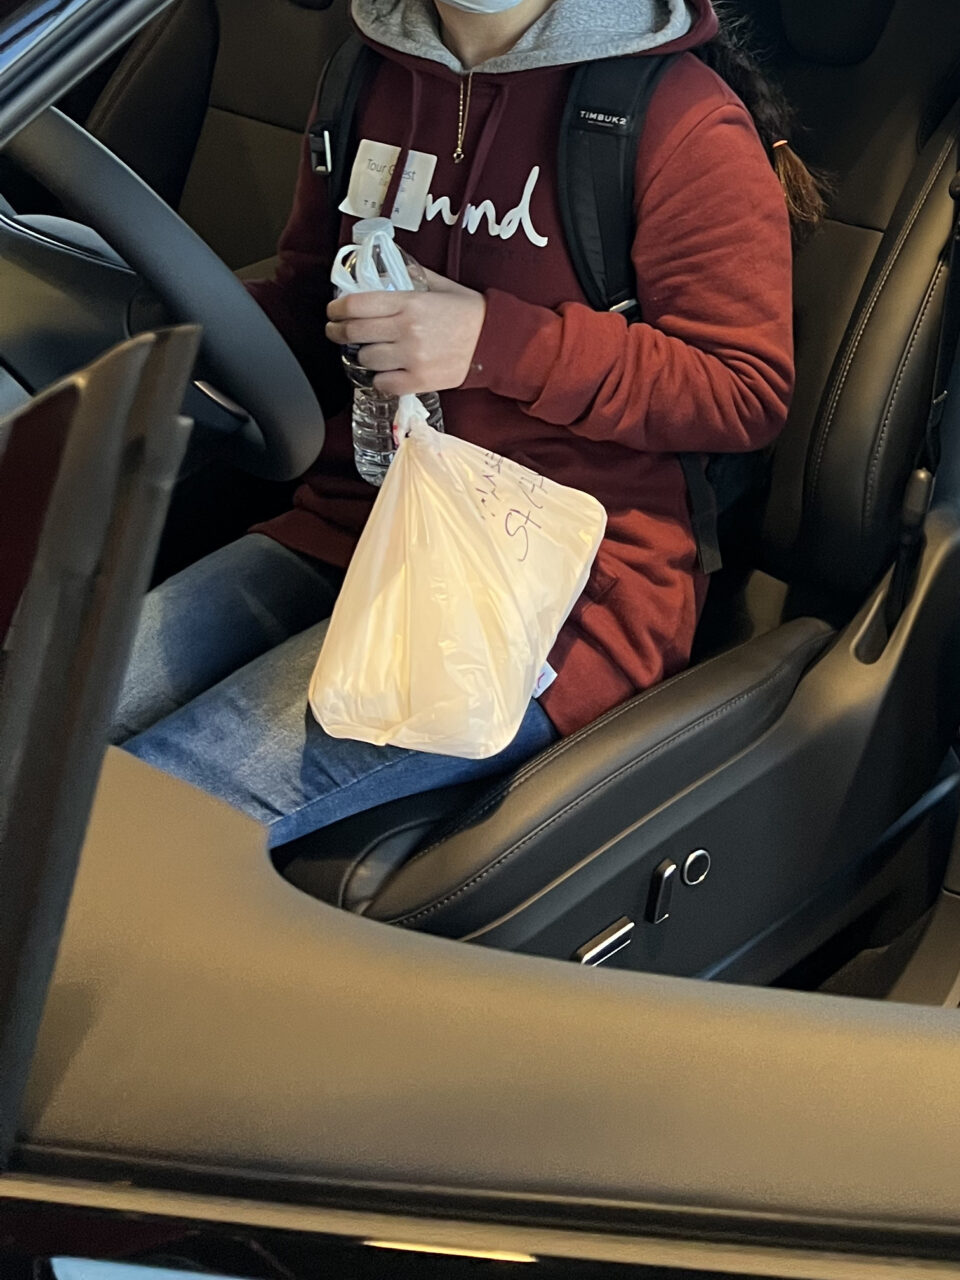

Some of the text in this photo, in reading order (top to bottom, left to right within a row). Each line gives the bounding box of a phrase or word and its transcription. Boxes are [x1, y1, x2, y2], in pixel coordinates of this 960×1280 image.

[580, 110, 627, 125] TIMBUK2
[367, 158, 416, 181] Tour Gest
